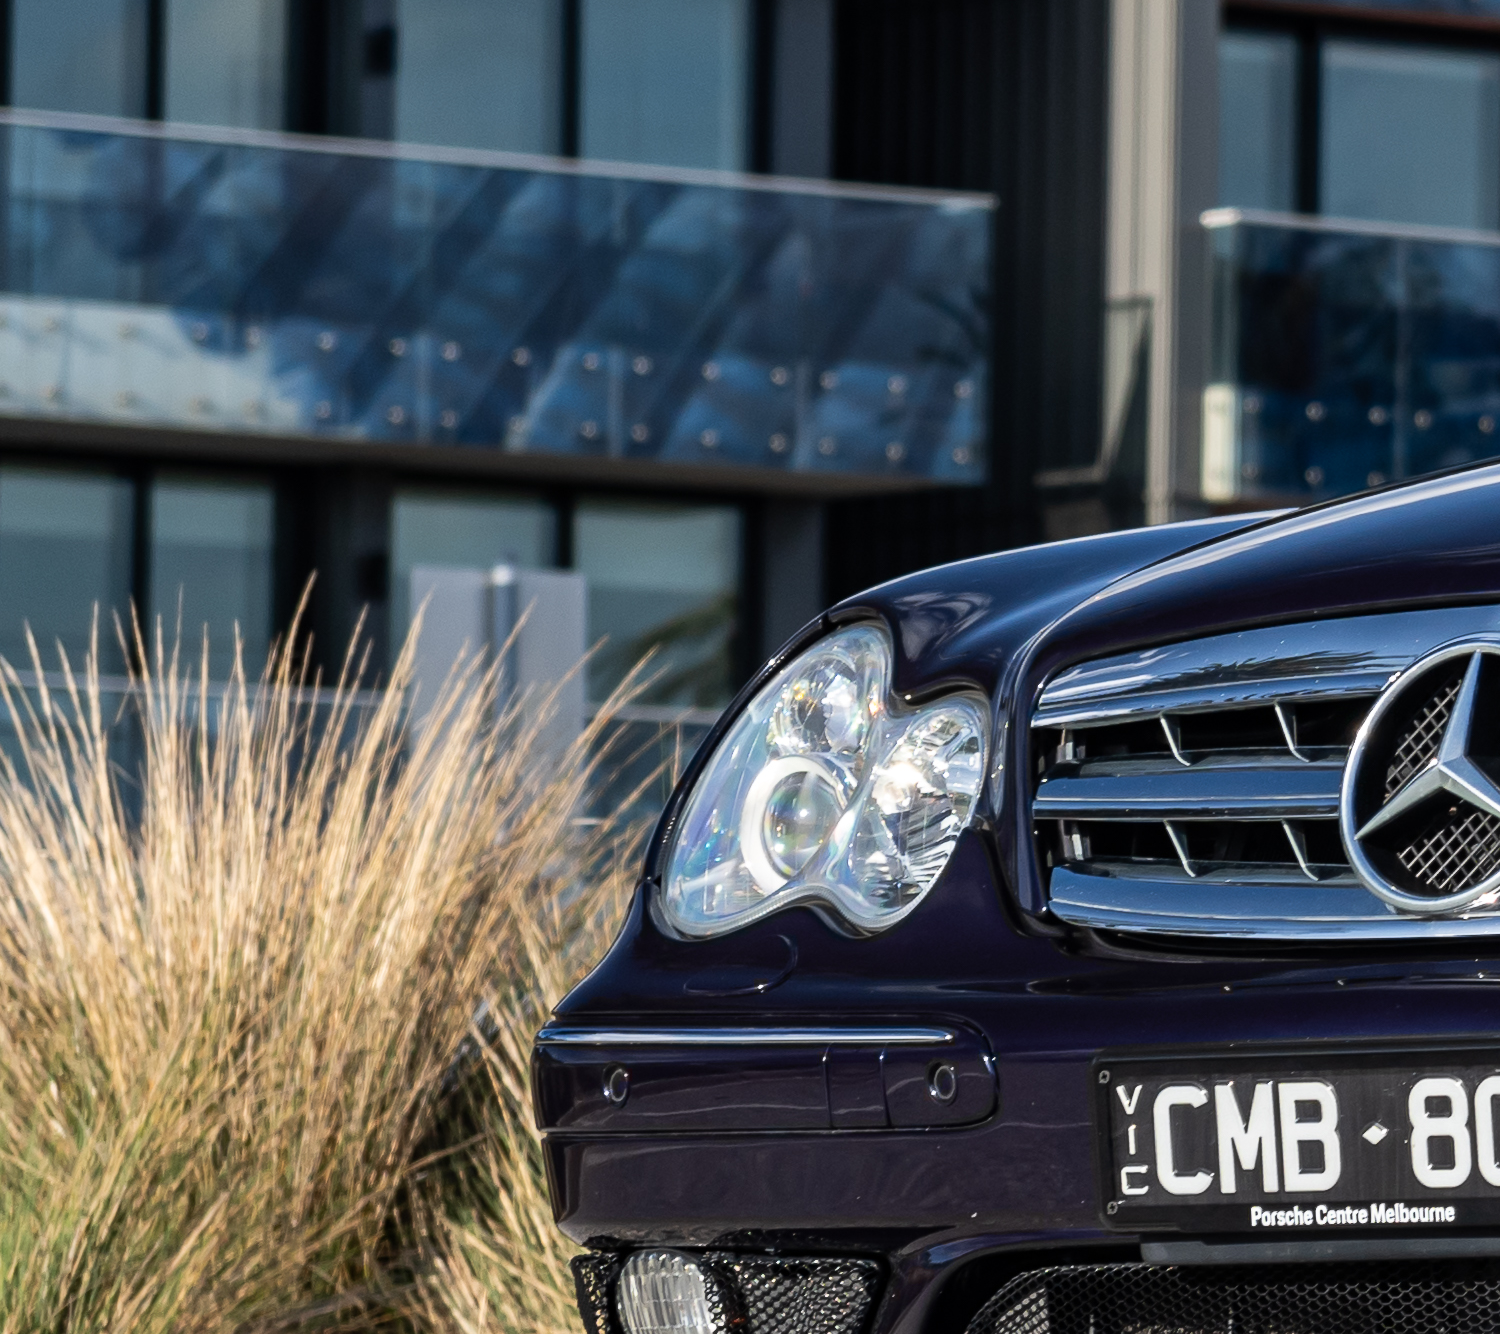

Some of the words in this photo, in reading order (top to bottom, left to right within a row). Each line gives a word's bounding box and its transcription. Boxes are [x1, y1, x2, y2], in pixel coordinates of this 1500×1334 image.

[1115, 1084, 1150, 1197] VIC
[1250, 1205, 1314, 1227] Porsche
[1315, 1204, 1369, 1226] Centre
[1370, 1202, 1456, 1224] Melbourne
